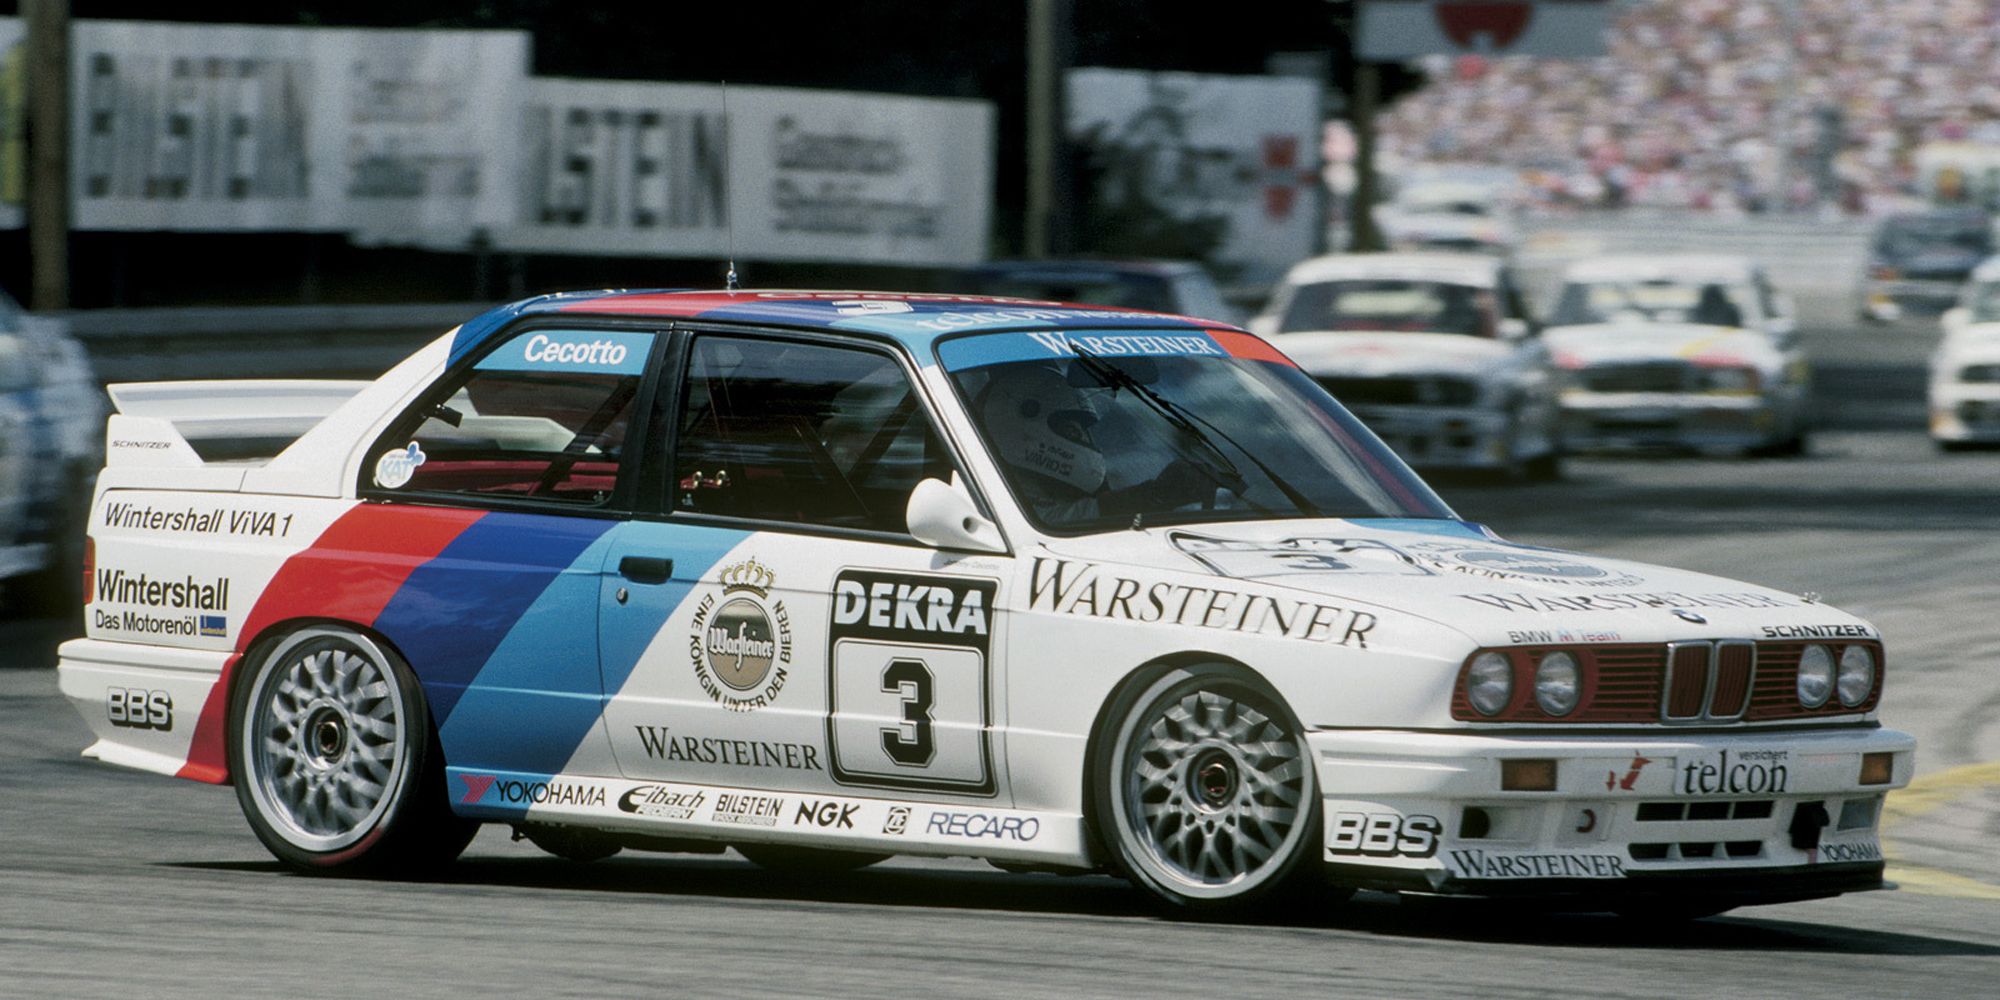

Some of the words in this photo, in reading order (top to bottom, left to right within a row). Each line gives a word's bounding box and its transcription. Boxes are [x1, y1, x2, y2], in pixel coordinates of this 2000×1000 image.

[524, 334, 626, 364] Cecotto
[1026, 331, 1221, 356] WARSTEINER
[112, 440, 171, 449] SCHNITZER
[105, 502, 224, 533] Wintershall
[229, 508, 275, 536] ViVA
[280, 513, 293, 537] 1
[98, 569, 229, 611] Wintershall
[1029, 556, 1377, 649] WARSTEINER
[95, 609, 120, 630] Das
[123, 611, 197, 636] Motorenöl
[691, 593, 715, 632] EINE
[834, 580, 988, 636] DEKRA
[772, 599, 793, 664] BIEREN
[1508, 630, 1553, 644] BMW
[1557, 629, 1572, 643] M
[1762, 625, 1870, 638] SCHNITZER
[689, 635, 721, 703] KÖNIGIN
[764, 667, 788, 702] DEN
[107, 687, 172, 732] BBS
[722, 694, 768, 714] UNTER
[881, 657, 937, 767] 3
[635, 725, 823, 771] WARSTEINER
[1738, 750, 1788, 760] versichert
[1684, 749, 1788, 794] telcon
[496, 780, 606, 806] YOKOHAMA
[617, 785, 705, 813] Eibach
[715, 794, 784, 817] BILSTEIN
[794, 801, 860, 829] NGK
[926, 812, 1040, 841] RECARO
[1326, 811, 1442, 857] BBS
[1449, 850, 1628, 879] WARSTEINER
